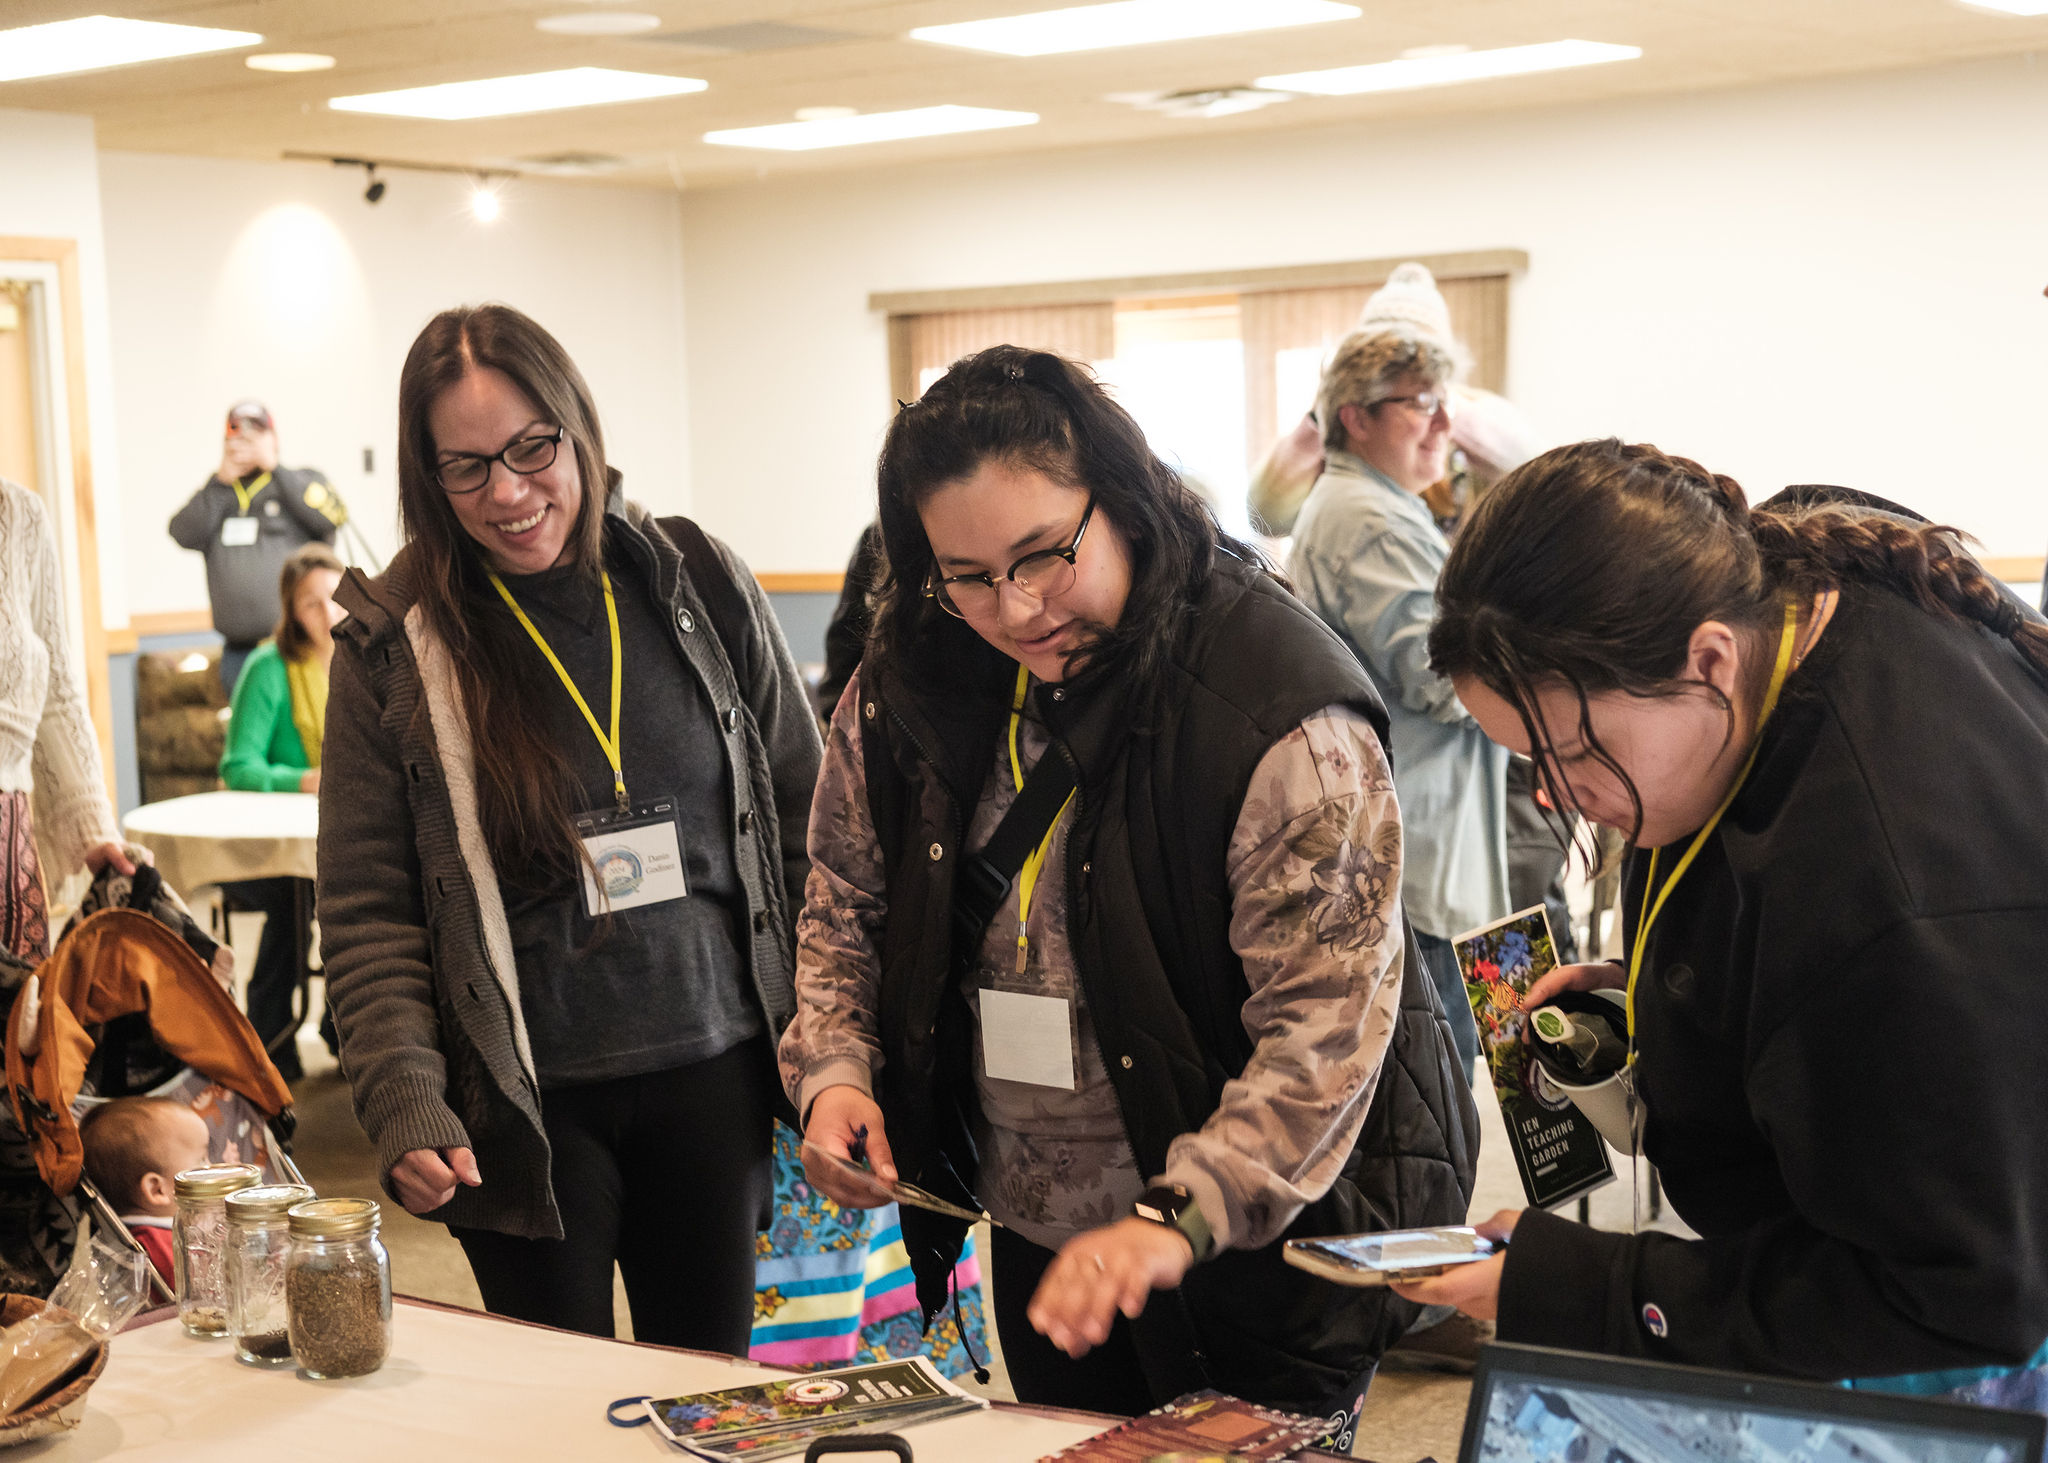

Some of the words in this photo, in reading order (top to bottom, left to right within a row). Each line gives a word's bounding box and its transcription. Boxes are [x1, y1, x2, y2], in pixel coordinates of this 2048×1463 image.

[1522, 1116, 1540, 1134] IEN
[1527, 1119, 1575, 1150] TEACHING
[1531, 1140, 1570, 1168] GARDEN
